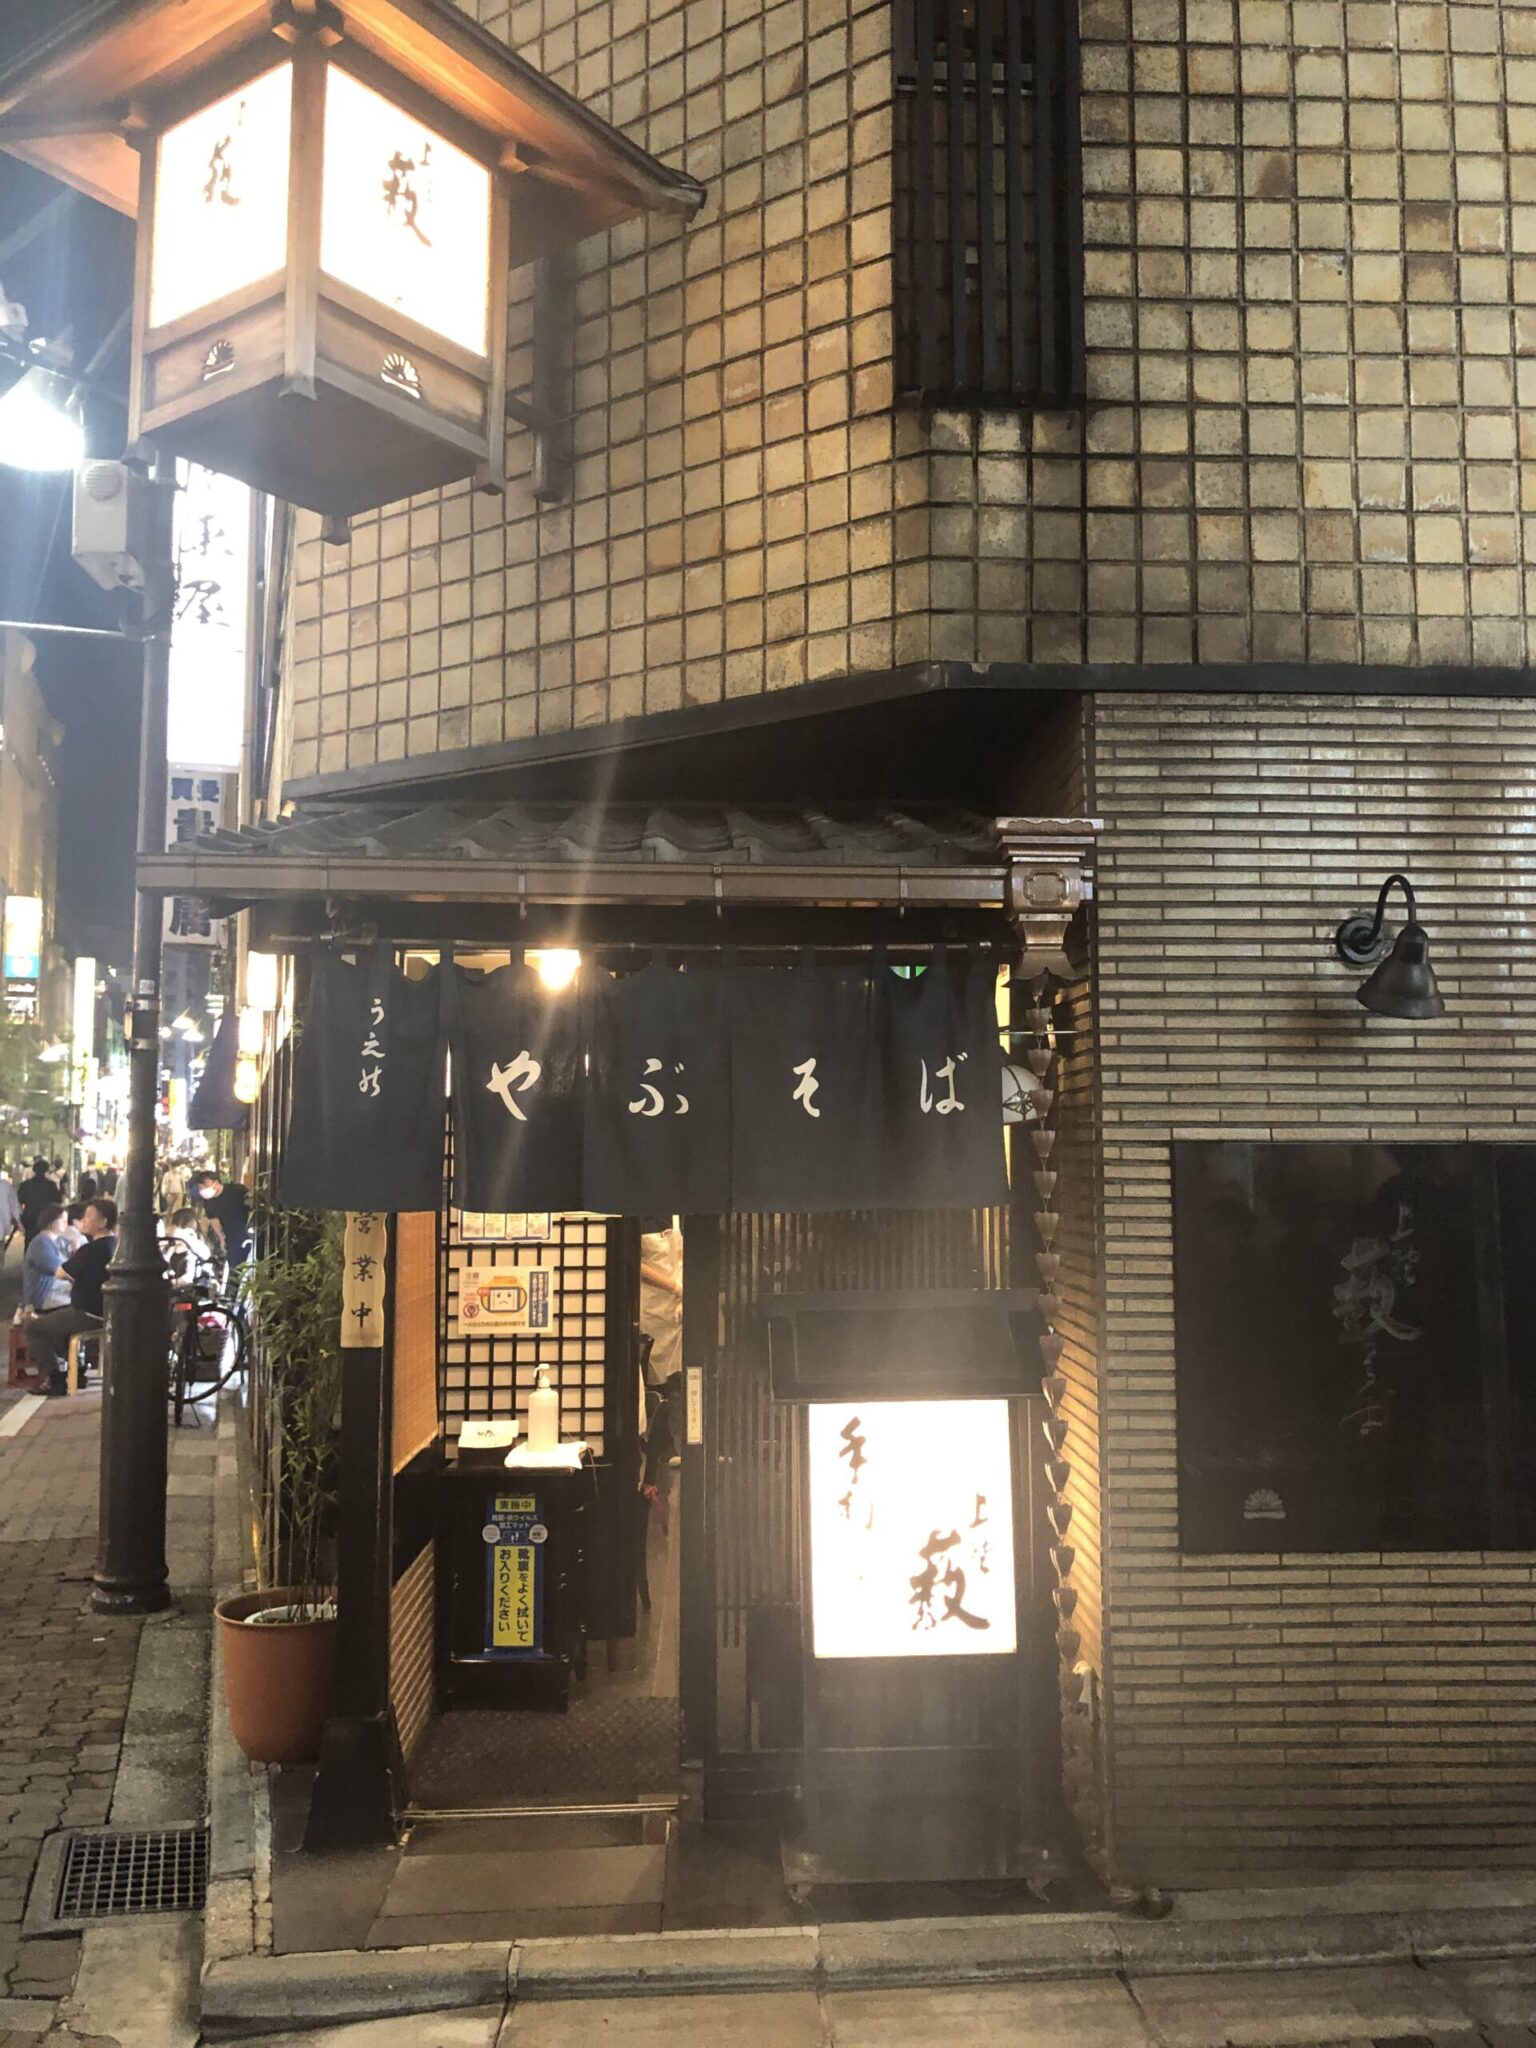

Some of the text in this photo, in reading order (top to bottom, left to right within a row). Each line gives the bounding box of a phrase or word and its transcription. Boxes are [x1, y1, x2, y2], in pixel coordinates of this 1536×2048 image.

[485, 1050, 969, 1121] やぶそば
[499, 1500, 532, 1510] 実施中
[497, 1549, 512, 1632] お入りください
[516, 1548, 531, 1642] 靴裏をよく拭いて
